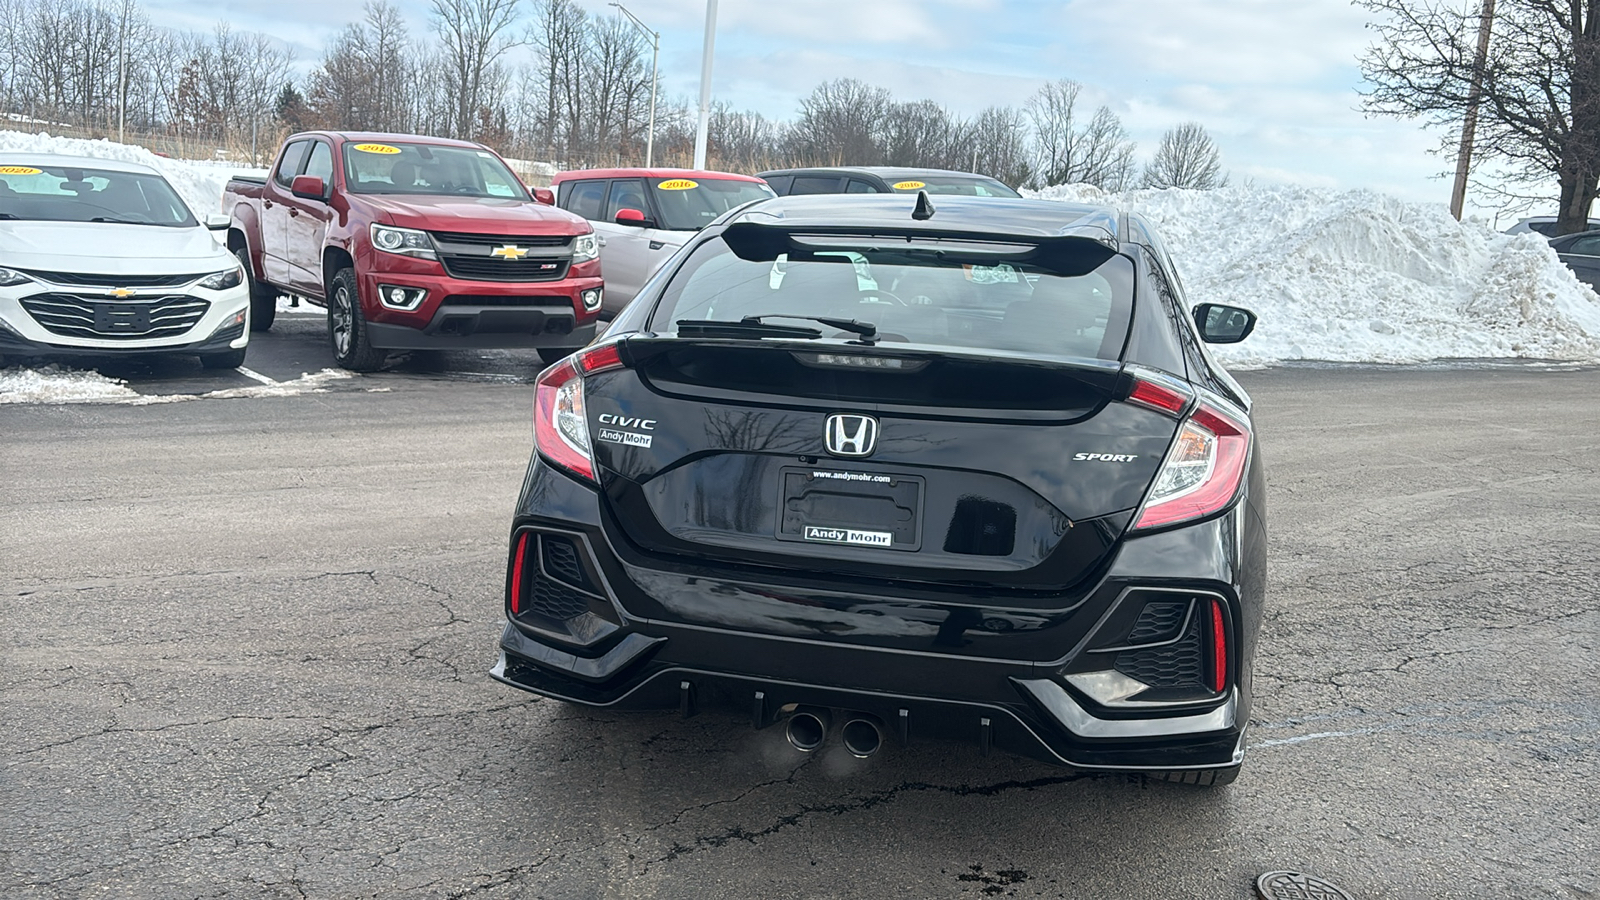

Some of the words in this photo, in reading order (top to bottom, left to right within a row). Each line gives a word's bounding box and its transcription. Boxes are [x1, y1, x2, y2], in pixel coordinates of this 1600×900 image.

[362, 145, 393, 153] 2015
[666, 181, 691, 189] 2016
[598, 413, 657, 430] CIVIC
[600, 430, 624, 443] Andy
[625, 433, 650, 445] Mohr
[1072, 452, 1139, 463] SPORT
[813, 471, 891, 483] www.andymohr.com
[810, 528, 845, 540] Andy
[850, 533, 888, 543] Mohr
